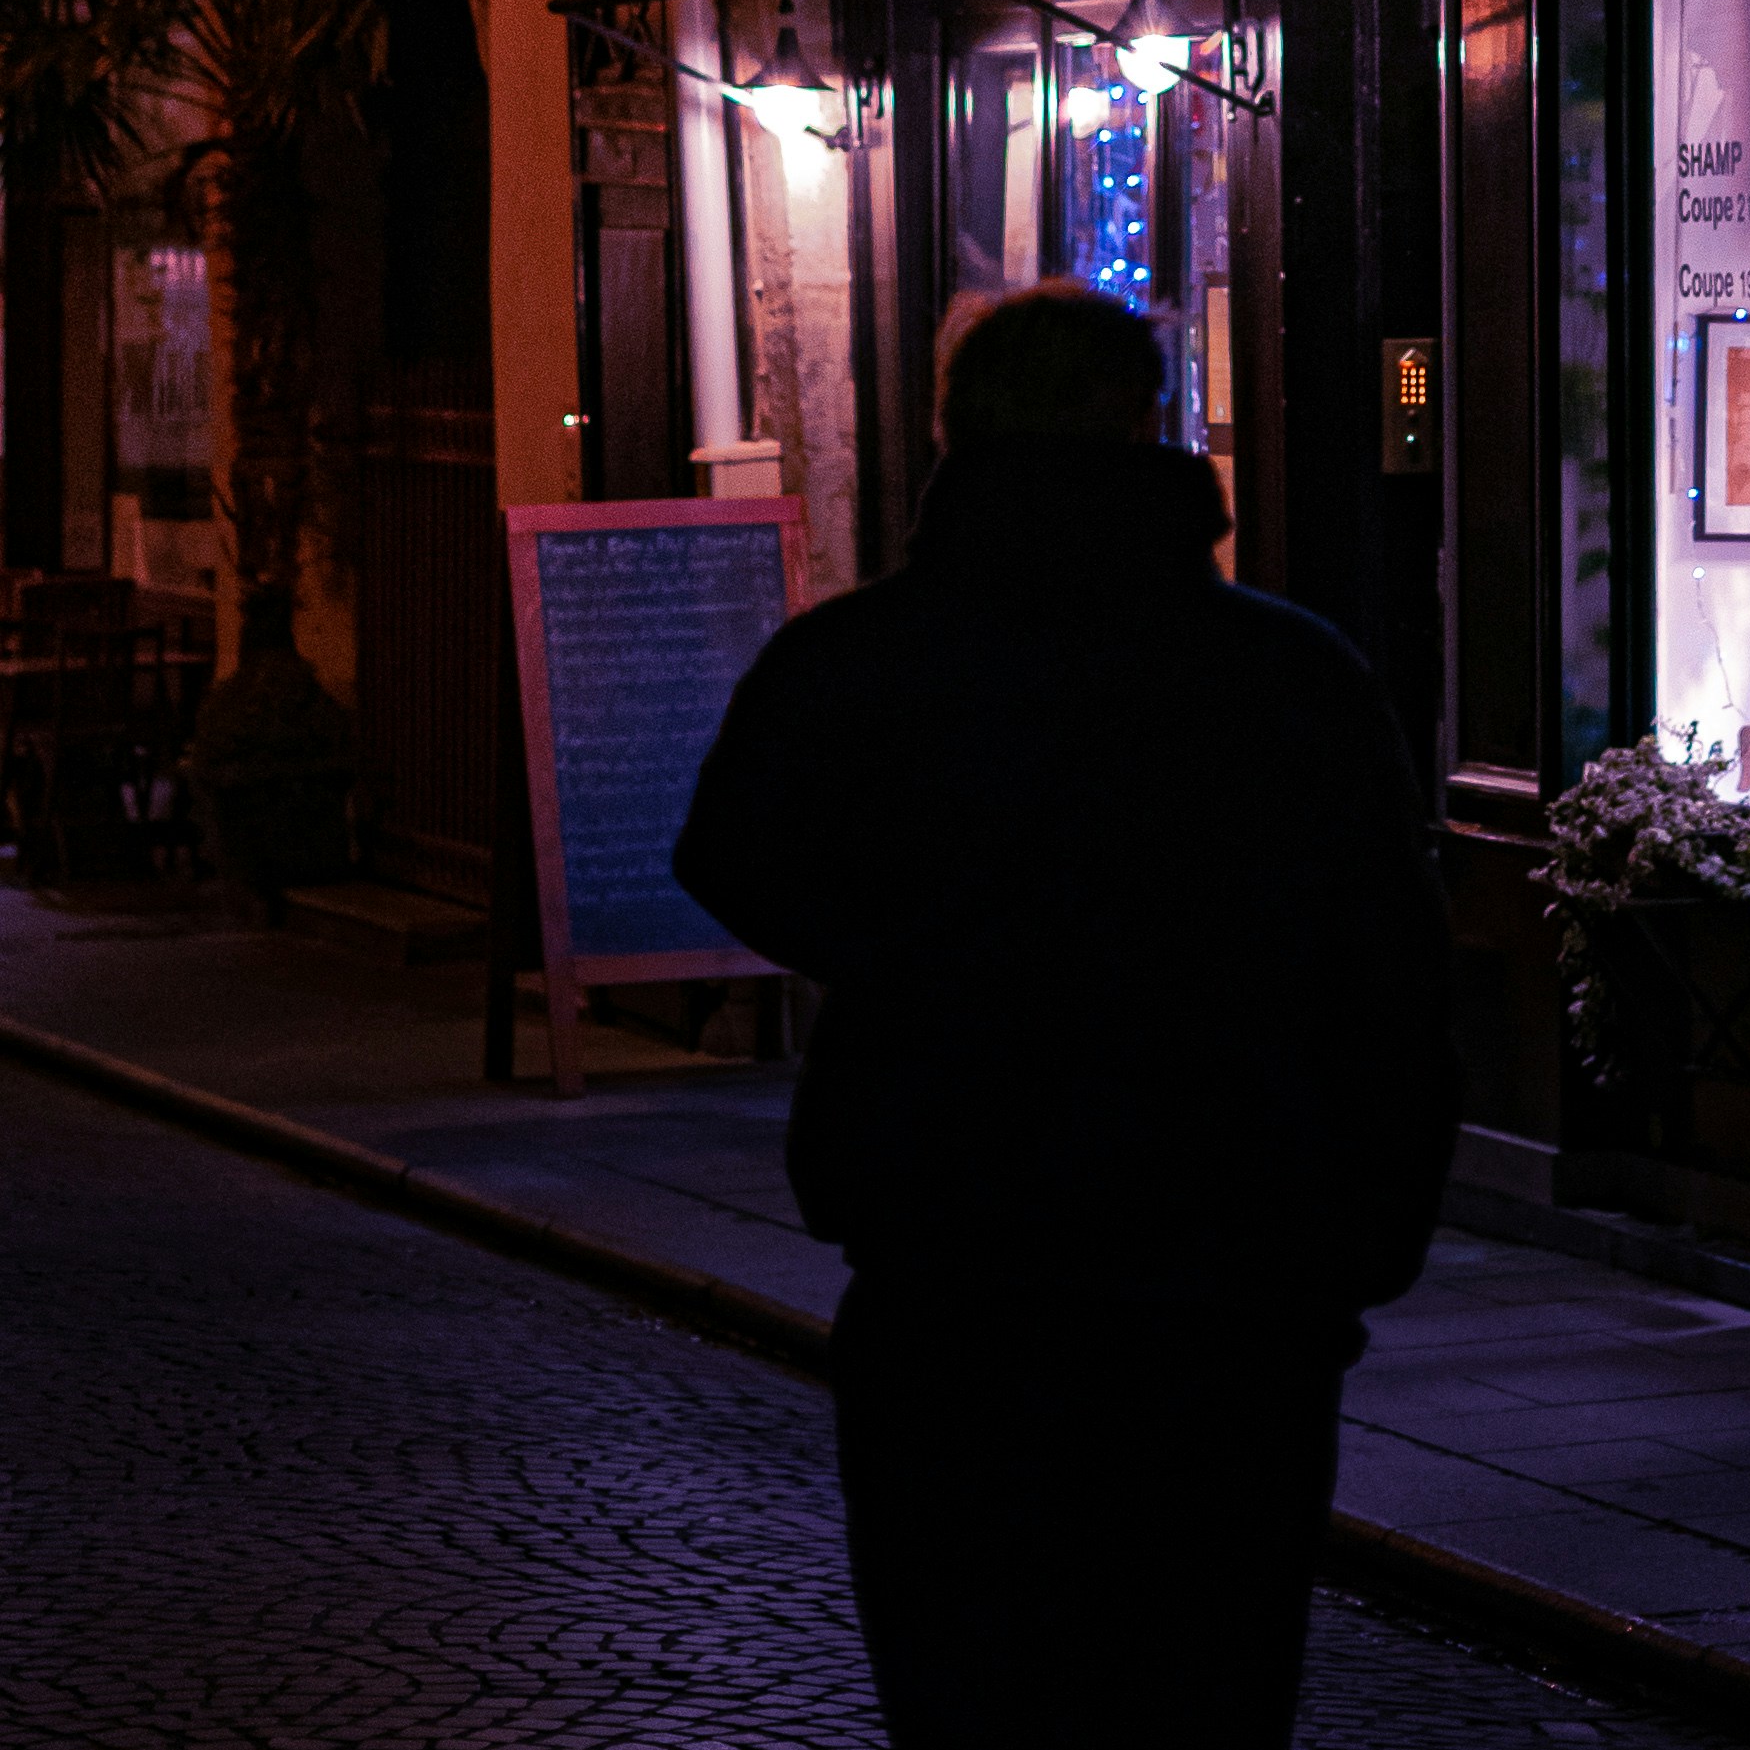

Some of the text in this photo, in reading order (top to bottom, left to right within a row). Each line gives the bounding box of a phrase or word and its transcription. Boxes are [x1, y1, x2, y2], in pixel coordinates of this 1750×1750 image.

[1678, 140, 1744, 179] SHAMP
[1678, 187, 1735, 231] Coupe
[1678, 262, 1735, 308] Coupe
